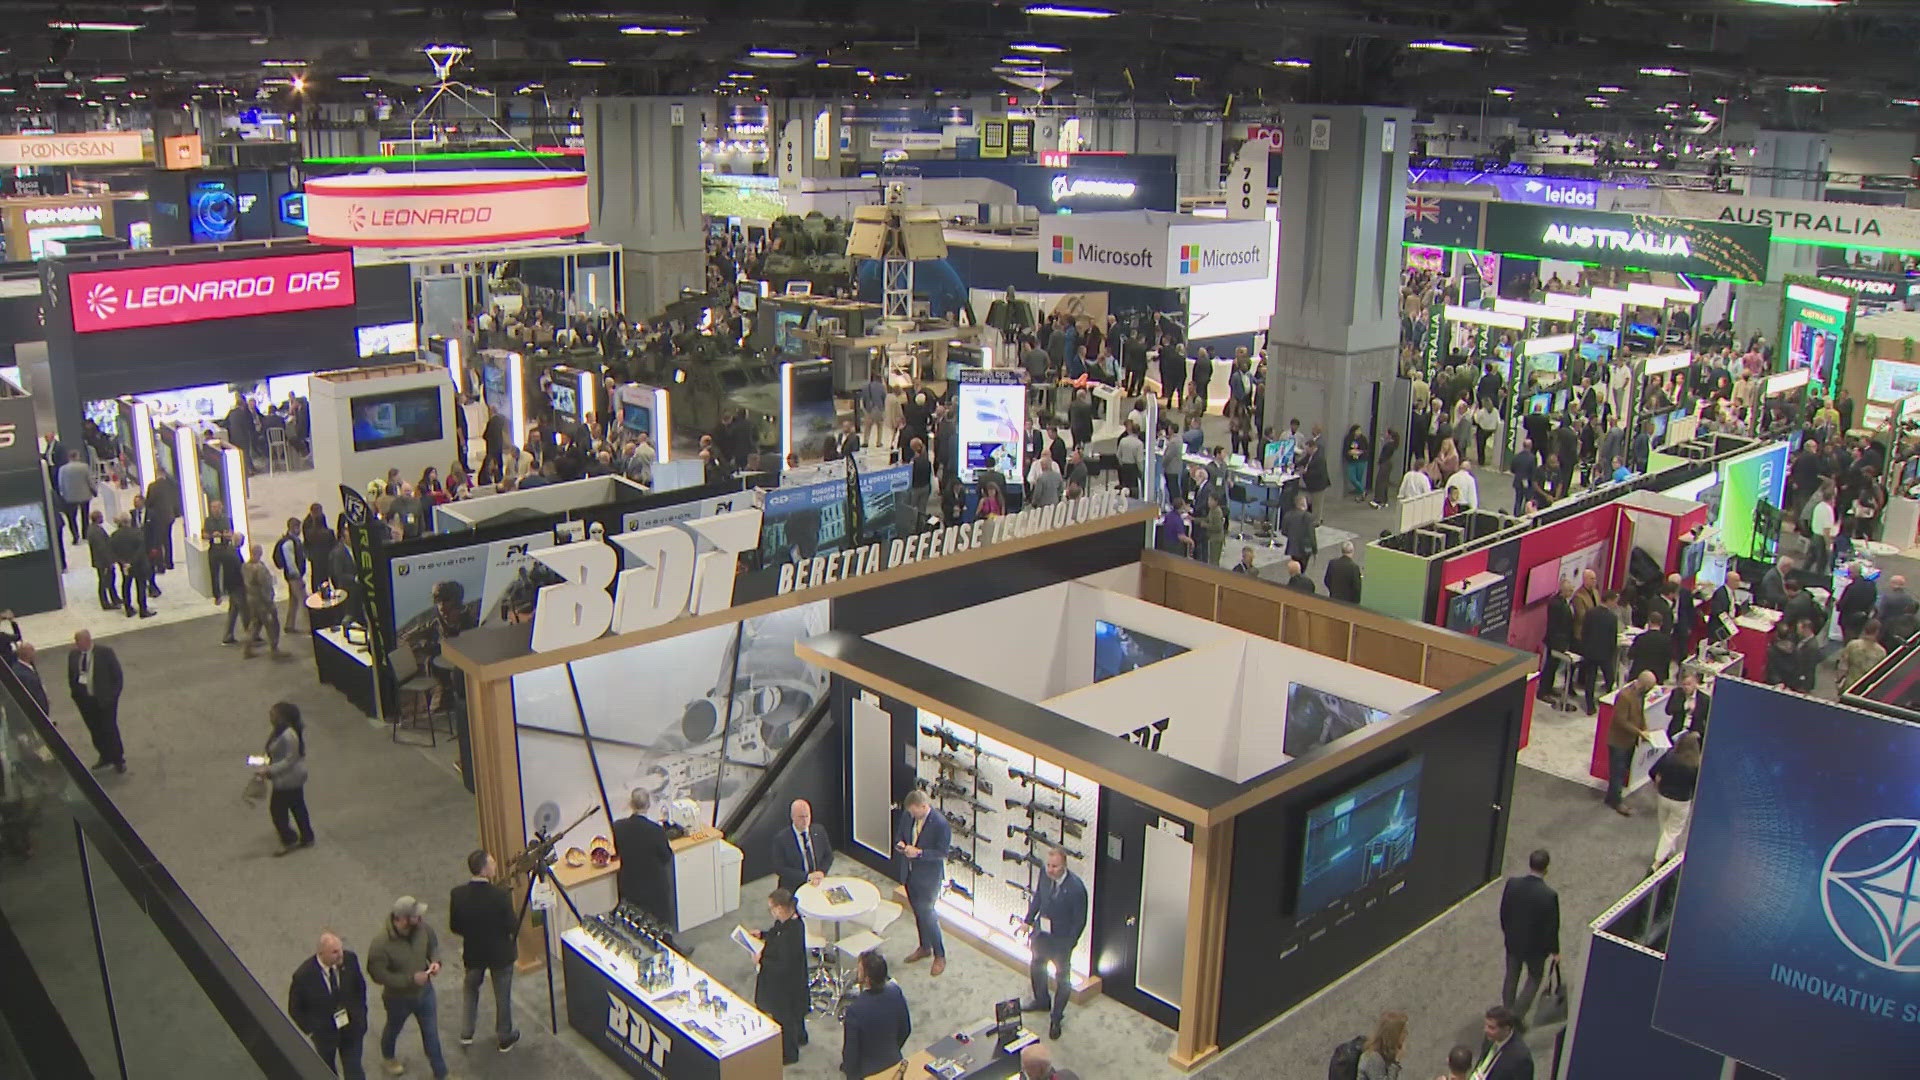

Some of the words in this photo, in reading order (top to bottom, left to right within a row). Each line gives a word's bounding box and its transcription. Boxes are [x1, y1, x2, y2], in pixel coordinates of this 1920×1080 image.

[20, 141, 115, 158] POONGSAN
[1241, 167, 1252, 209] 700
[1545, 185, 1595, 205] leidos
[371, 207, 492, 226] LEONARDO
[1718, 206, 1881, 236] AUSTRALIA
[1078, 243, 1152, 268] Microsoft
[1202, 245, 1260, 268] Microsoft
[1542, 223, 1691, 257] AUSTRALIA
[125, 275, 275, 309] LEONARDO
[287, 271, 341, 293] DRS
[778, 543, 881, 596] BERETTA
[888, 522, 982, 568] DEFENSE
[990, 487, 1131, 546] TECHNOLOGIES
[418, 556, 475, 571] REVISION
[526, 509, 764, 653] BDT
[1119, 717, 1170, 752] DT
[1770, 963, 1896, 1018] INNOVATIVE
[607, 991, 673, 1068] BDT
